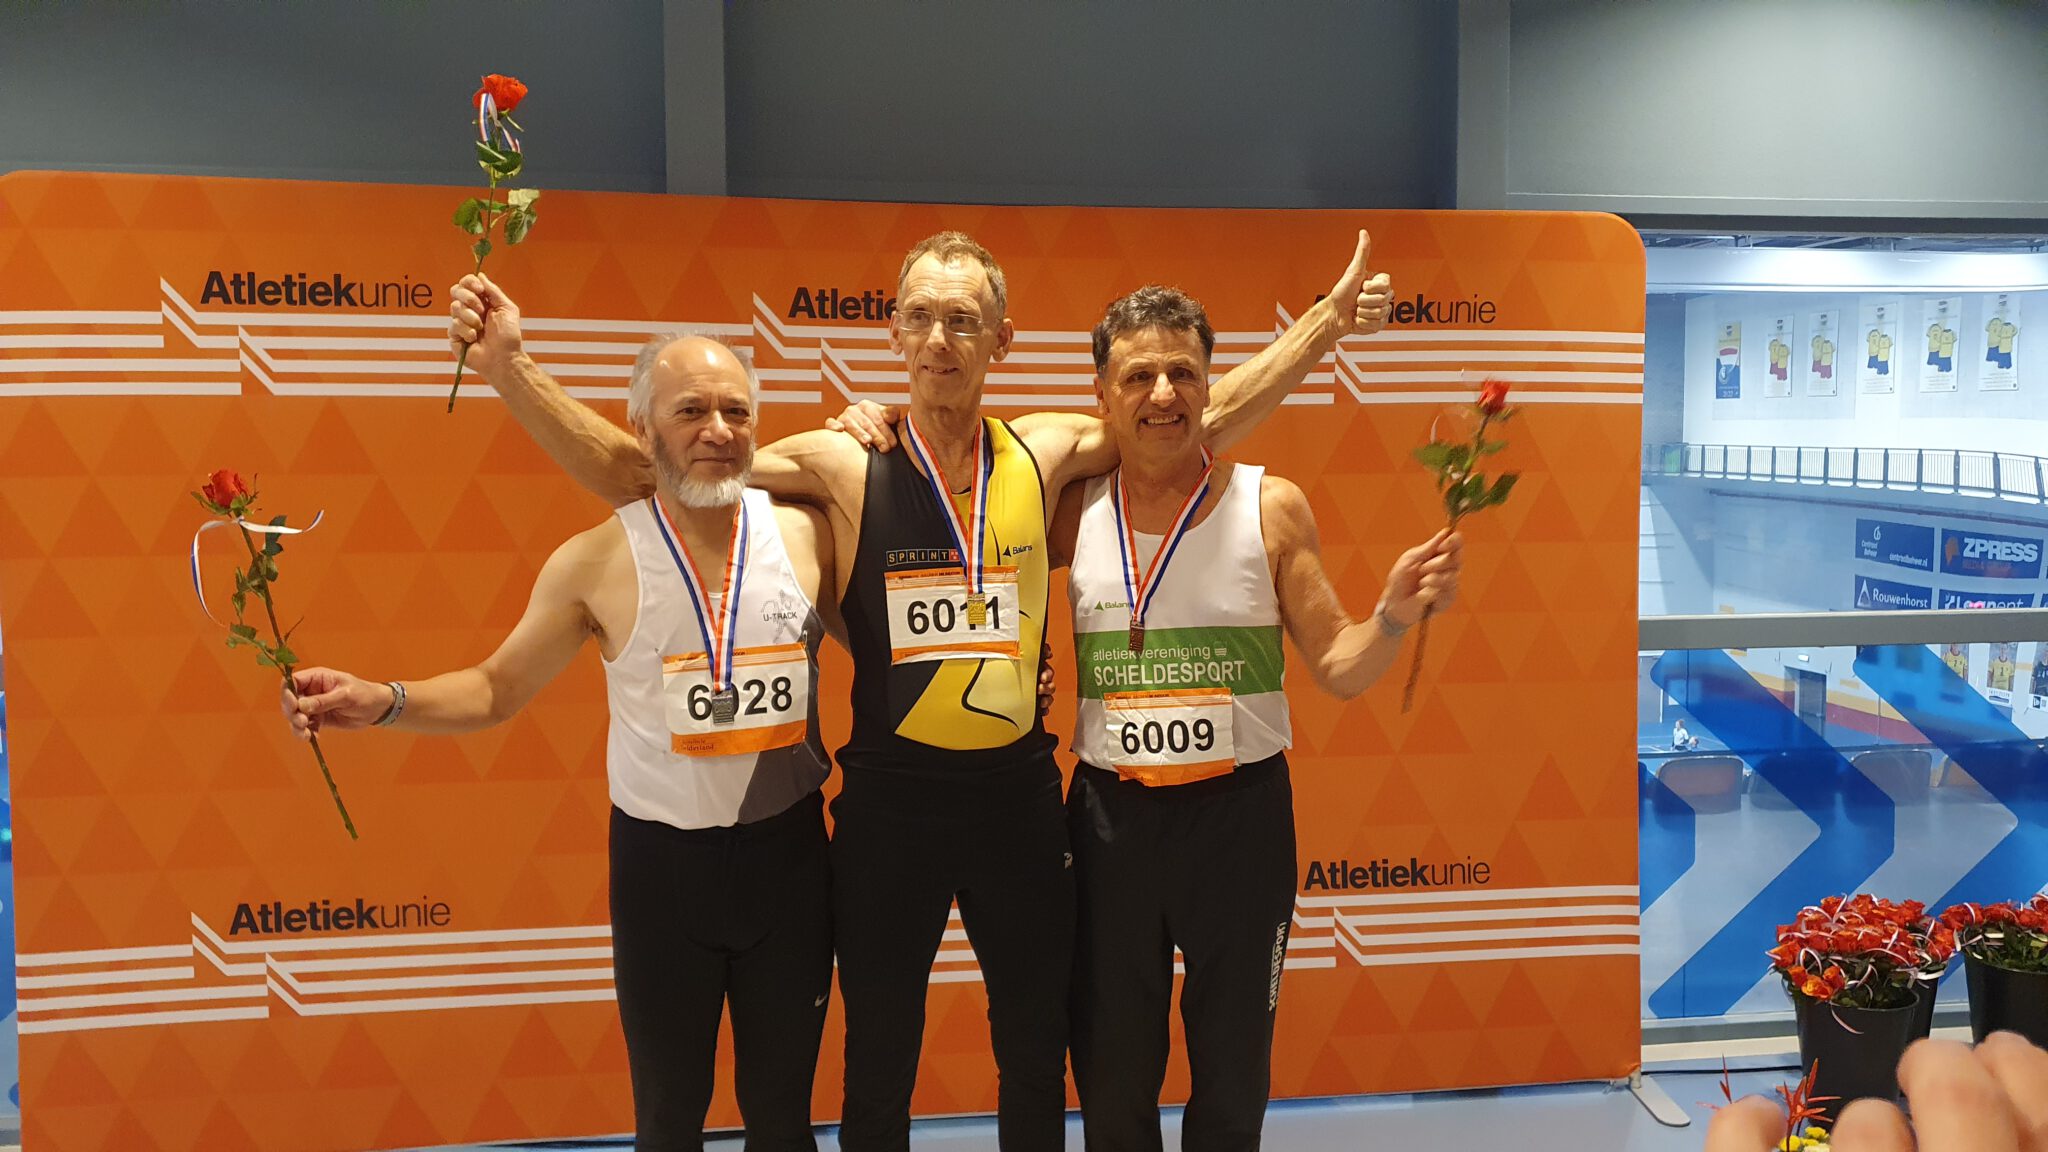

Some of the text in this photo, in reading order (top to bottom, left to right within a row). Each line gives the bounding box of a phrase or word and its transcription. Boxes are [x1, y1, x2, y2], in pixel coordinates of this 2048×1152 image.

[200, 270, 433, 309] Atletiekunie
[888, 551, 948, 563] SPRINT
[1963, 537, 2038, 563] ZPRESS
[1104, 601, 1130, 609] Balan
[1872, 587, 1928, 608] Rouwenhorst
[763, 611, 798, 622] U-TRACK
[1093, 660, 1246, 687] SCHELDESPORT
[1120, 718, 1215, 754] 6009
[1303, 856, 1491, 891] Atletiekunie
[229, 895, 451, 935] Atletiekunie
